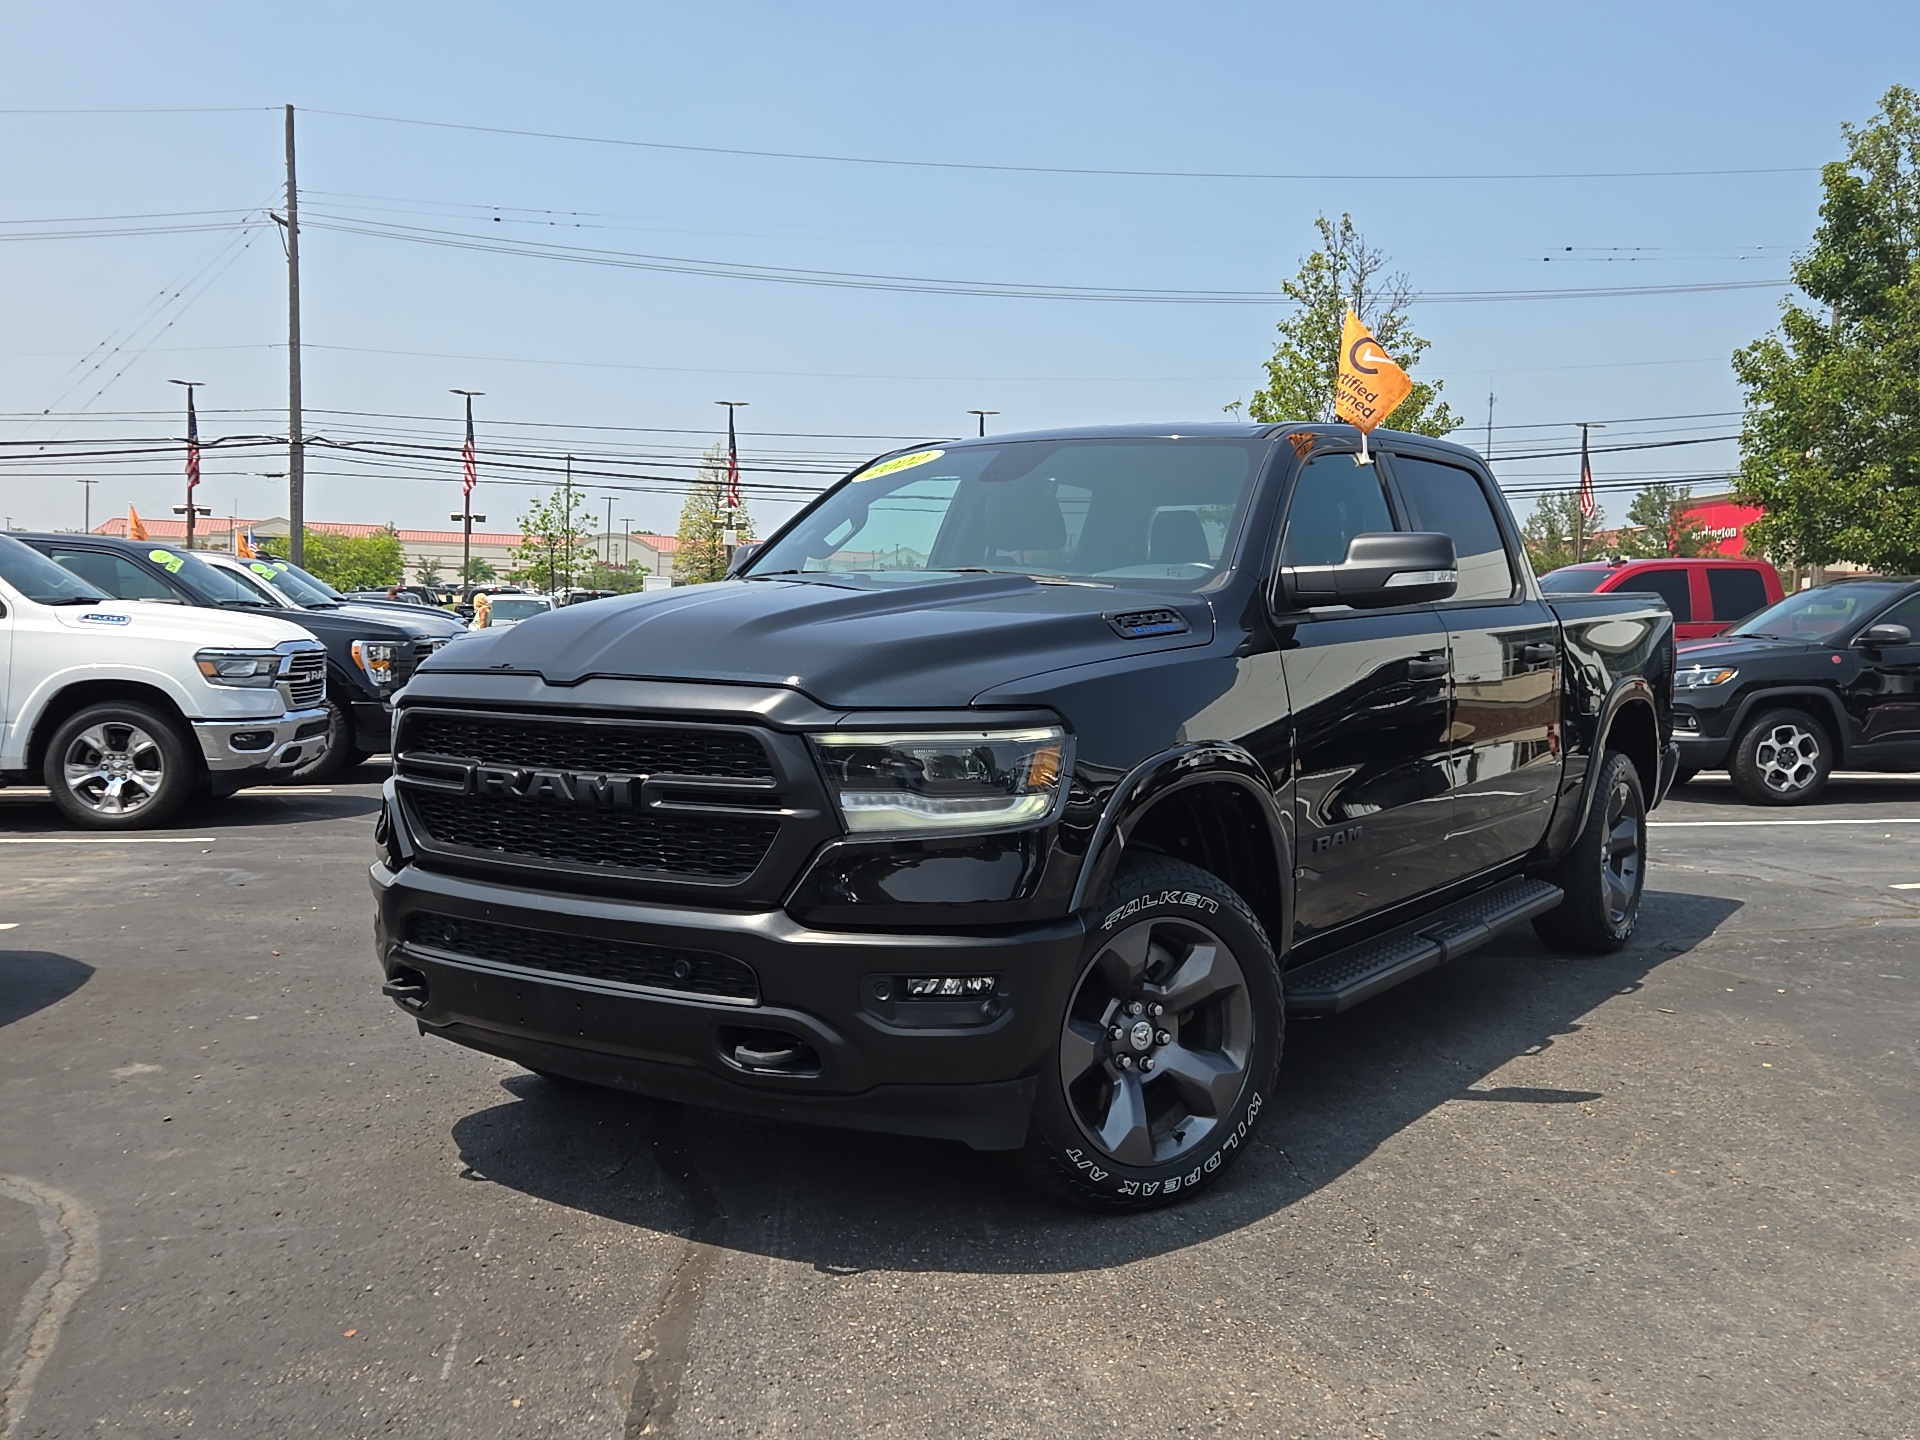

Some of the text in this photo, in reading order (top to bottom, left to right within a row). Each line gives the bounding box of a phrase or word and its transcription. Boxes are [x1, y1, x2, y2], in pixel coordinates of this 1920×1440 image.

[1337, 388, 1377, 419] wned
[1338, 372, 1379, 404] rtified
[1692, 525, 1737, 544] urlington
[477, 766, 637, 805] RAM
[1312, 826, 1363, 852] RAM
[1100, 890, 1219, 930] FALKEN
[1117, 1092, 1262, 1196] WILDPEAK
